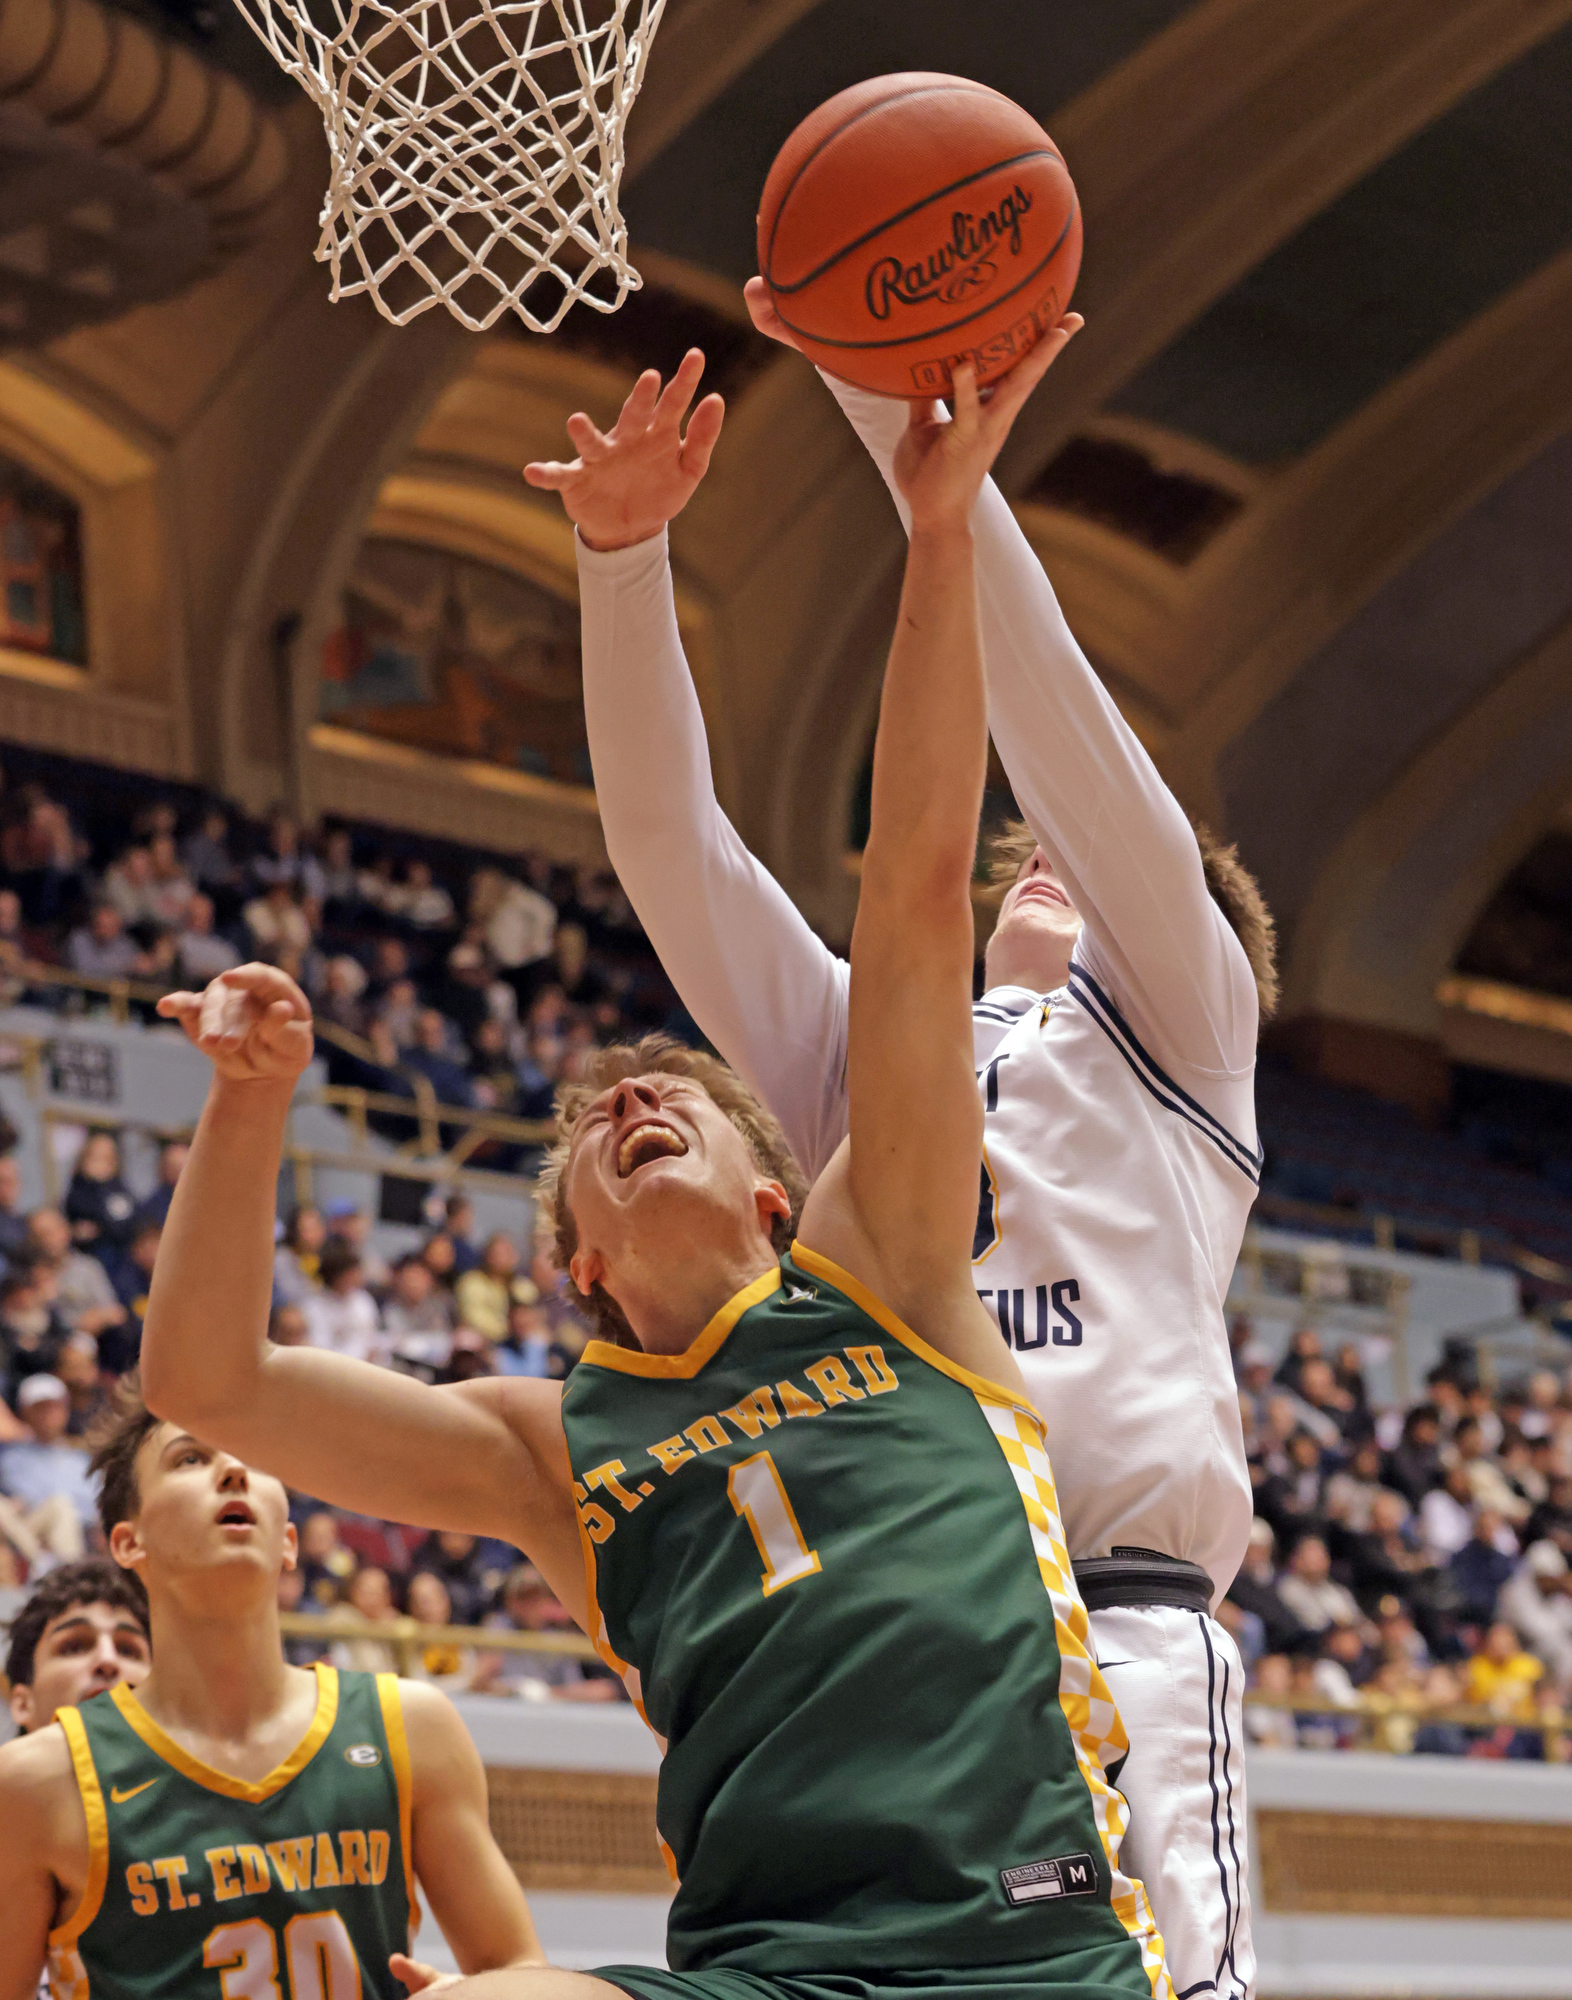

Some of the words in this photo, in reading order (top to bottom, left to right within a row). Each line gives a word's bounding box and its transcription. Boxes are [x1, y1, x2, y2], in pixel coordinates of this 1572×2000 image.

[865, 184, 1033, 320] Rawlings
[573, 1459, 656, 1544] ST.
[646, 1345, 899, 1475] EDWARD
[726, 1450, 823, 1598] 1
[125, 1855, 201, 1916] ST.
[205, 1829, 391, 1902] EDWARD
[1069, 1864, 1088, 1884] M
[202, 1909, 363, 2000] 30
